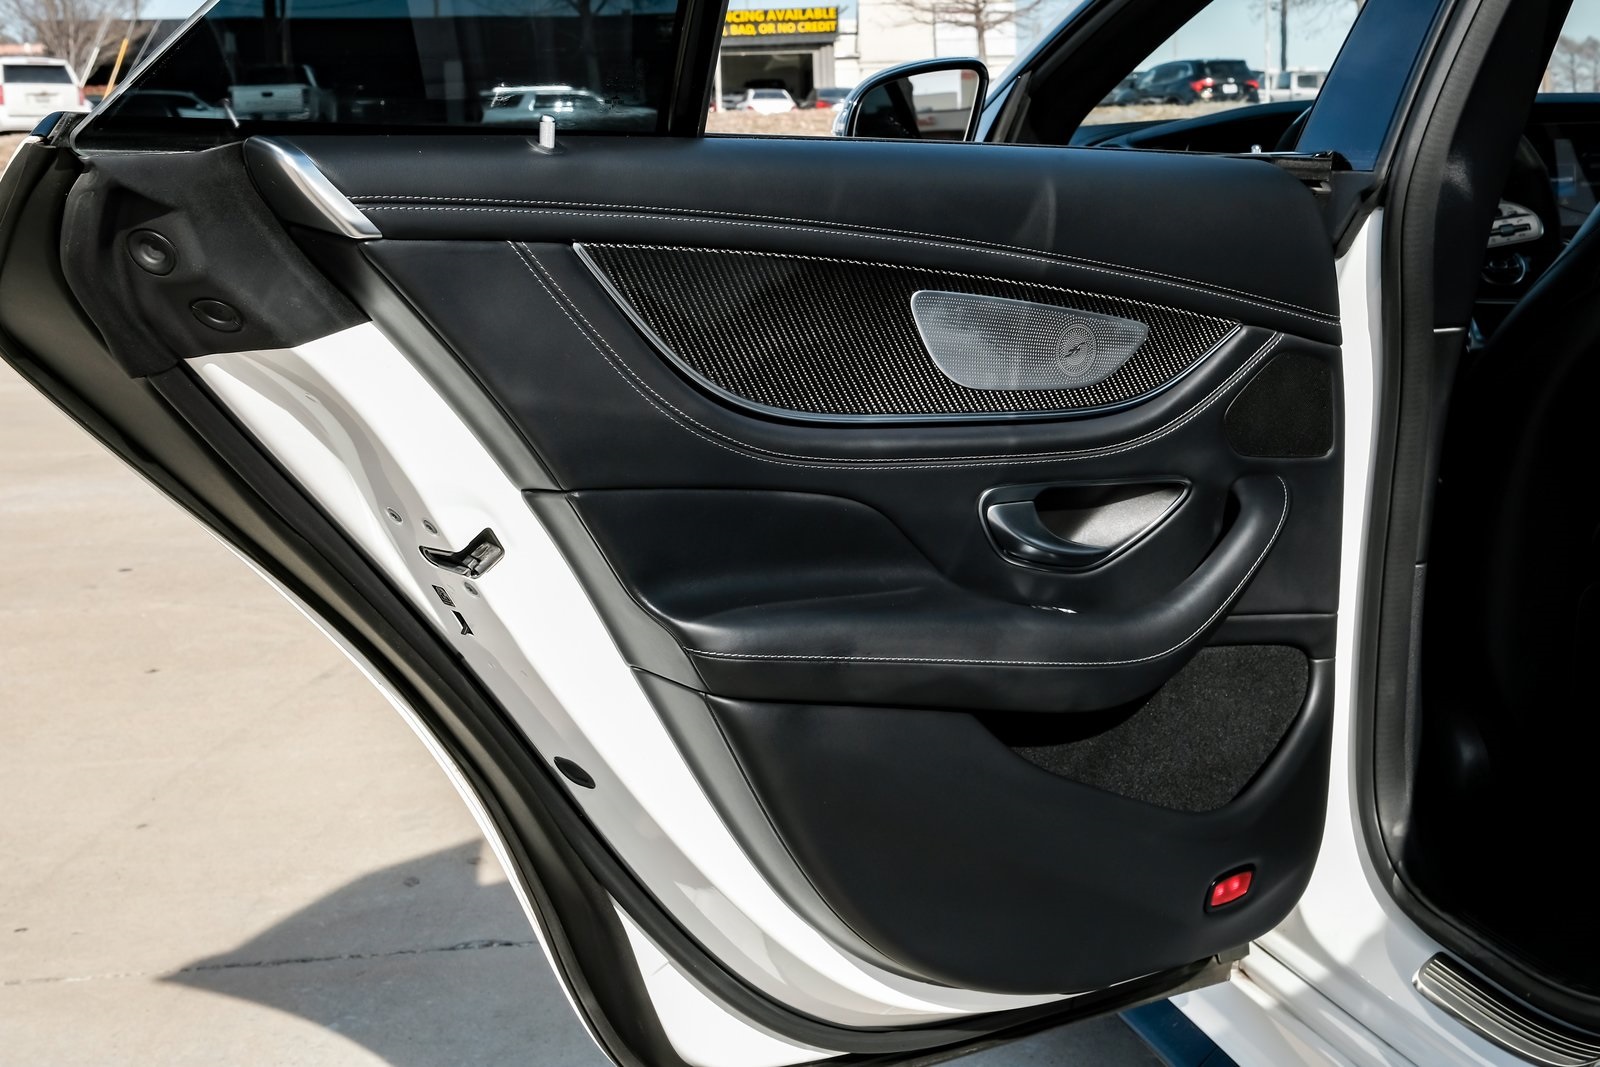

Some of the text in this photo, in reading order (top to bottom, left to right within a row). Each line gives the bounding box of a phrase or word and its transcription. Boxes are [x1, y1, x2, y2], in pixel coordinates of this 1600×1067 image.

[766, 7, 836, 21] AVAILABLE
[730, 23, 757, 37] BAD,
[758, 22, 776, 35] OR
[777, 22, 796, 34] NO
[797, 20, 837, 33] CREDIT
